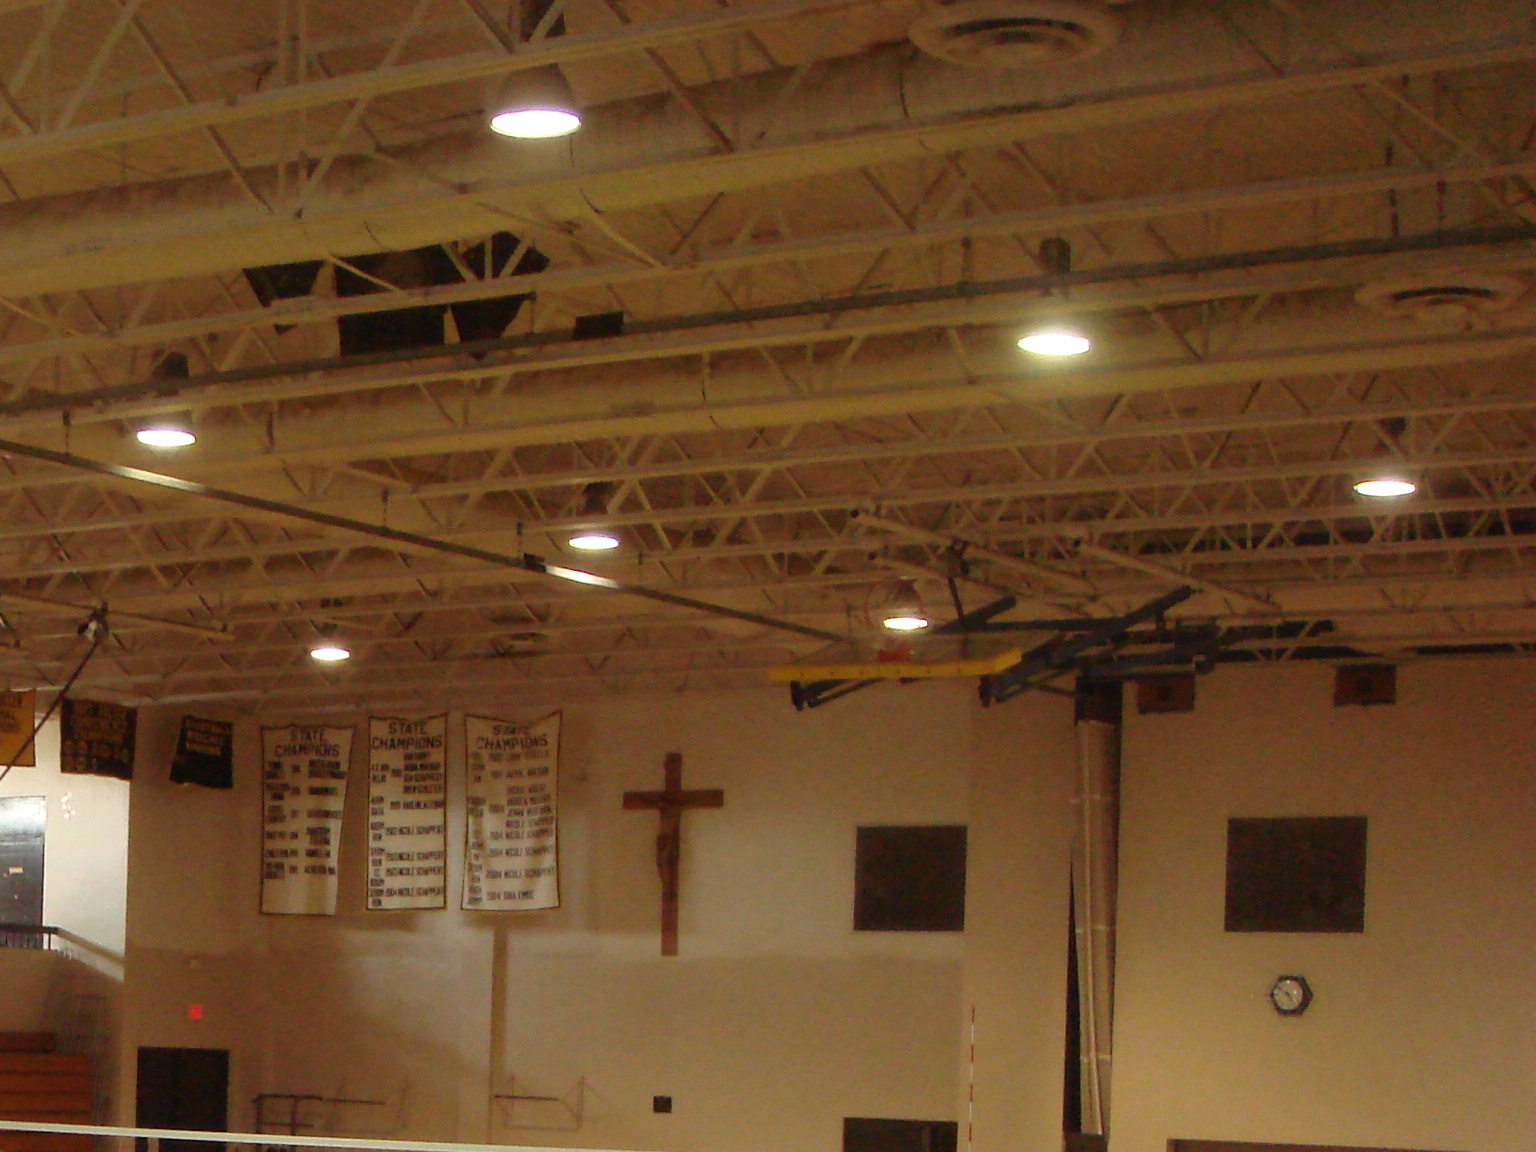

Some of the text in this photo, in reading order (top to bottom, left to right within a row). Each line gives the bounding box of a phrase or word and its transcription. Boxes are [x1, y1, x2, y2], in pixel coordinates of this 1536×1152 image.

[388, 721, 427, 735] STATE
[493, 724, 530, 735] STATE
[290, 729, 325, 743] STATE
[371, 735, 443, 750] CHAMPIONS
[476, 734, 548, 750] CHAMPIONS
[275, 743, 339, 757] CHAMPIONS
